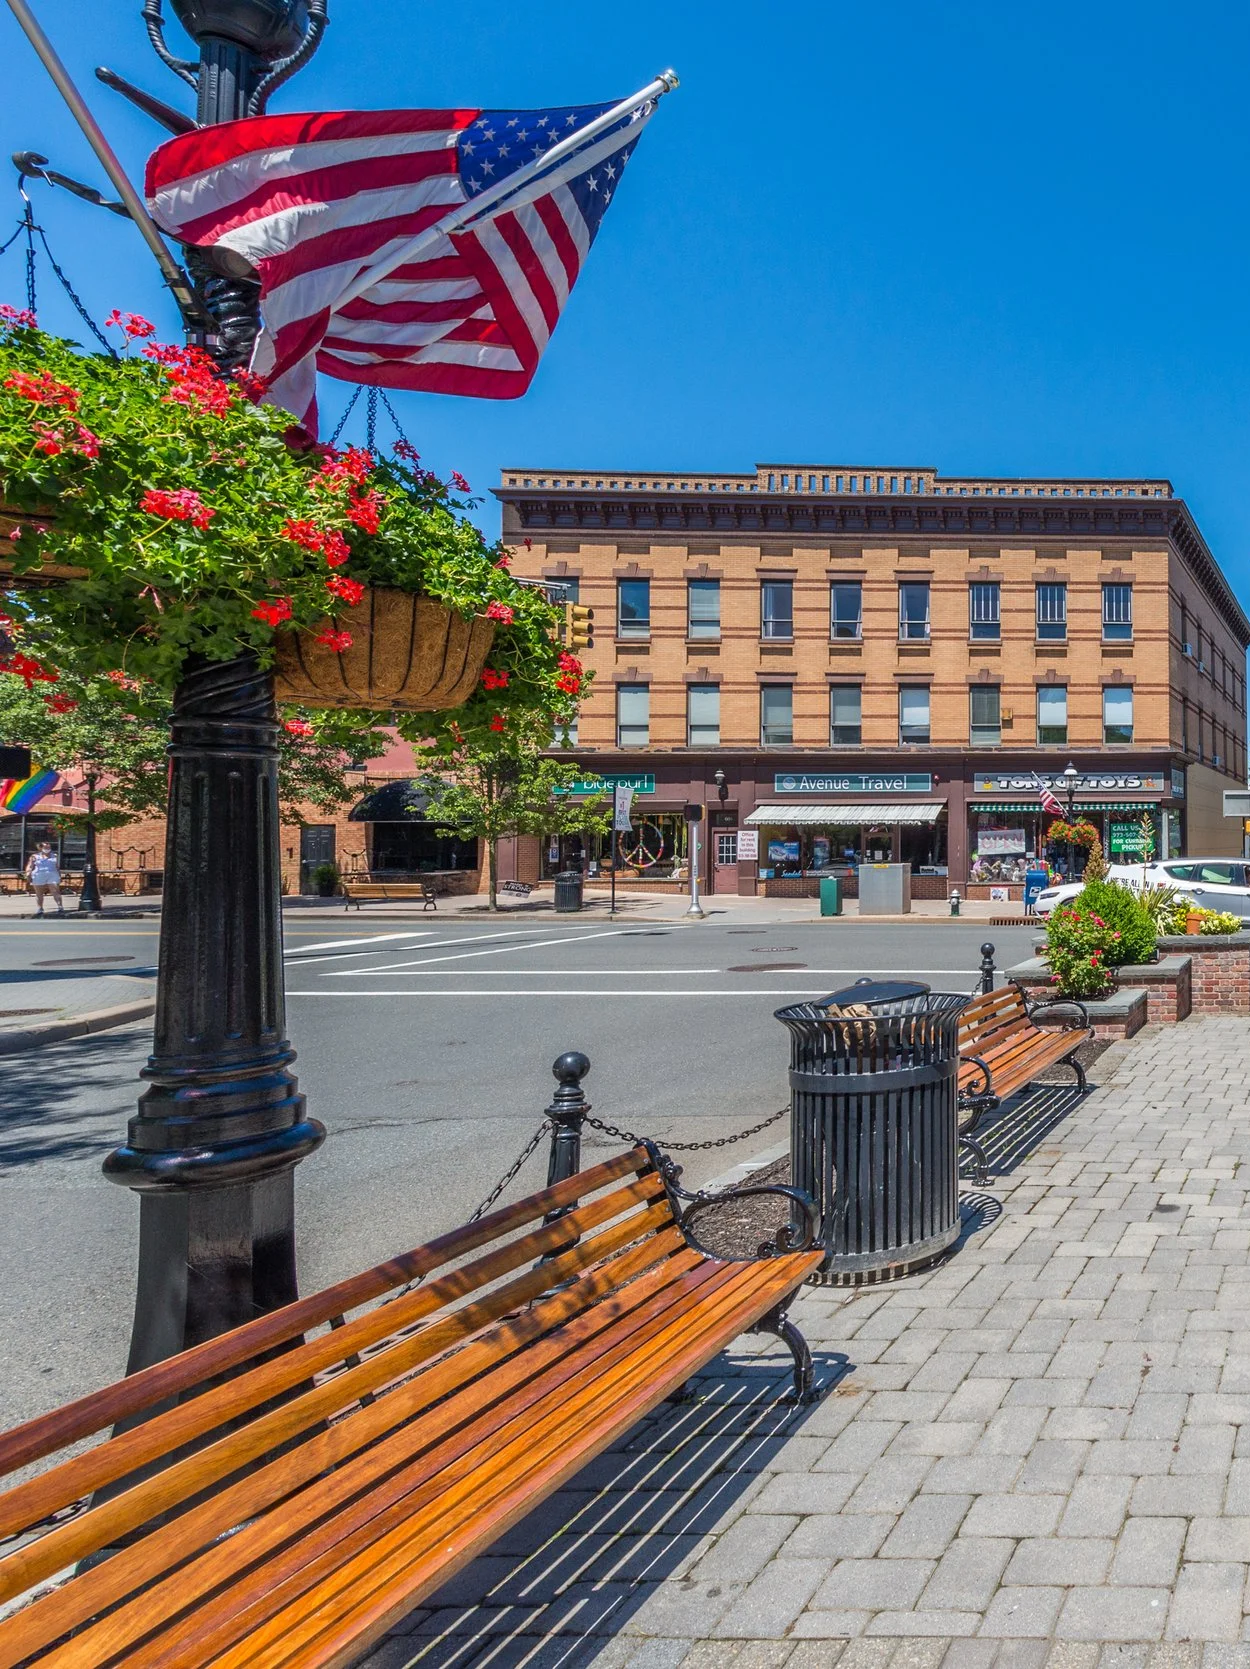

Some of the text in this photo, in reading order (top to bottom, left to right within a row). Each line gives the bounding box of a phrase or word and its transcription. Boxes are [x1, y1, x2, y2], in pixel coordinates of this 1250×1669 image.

[799, 775, 907, 790] Avenue Travel
[997, 776, 1052, 789] TONS
[1087, 775, 1142, 789] TOYS
